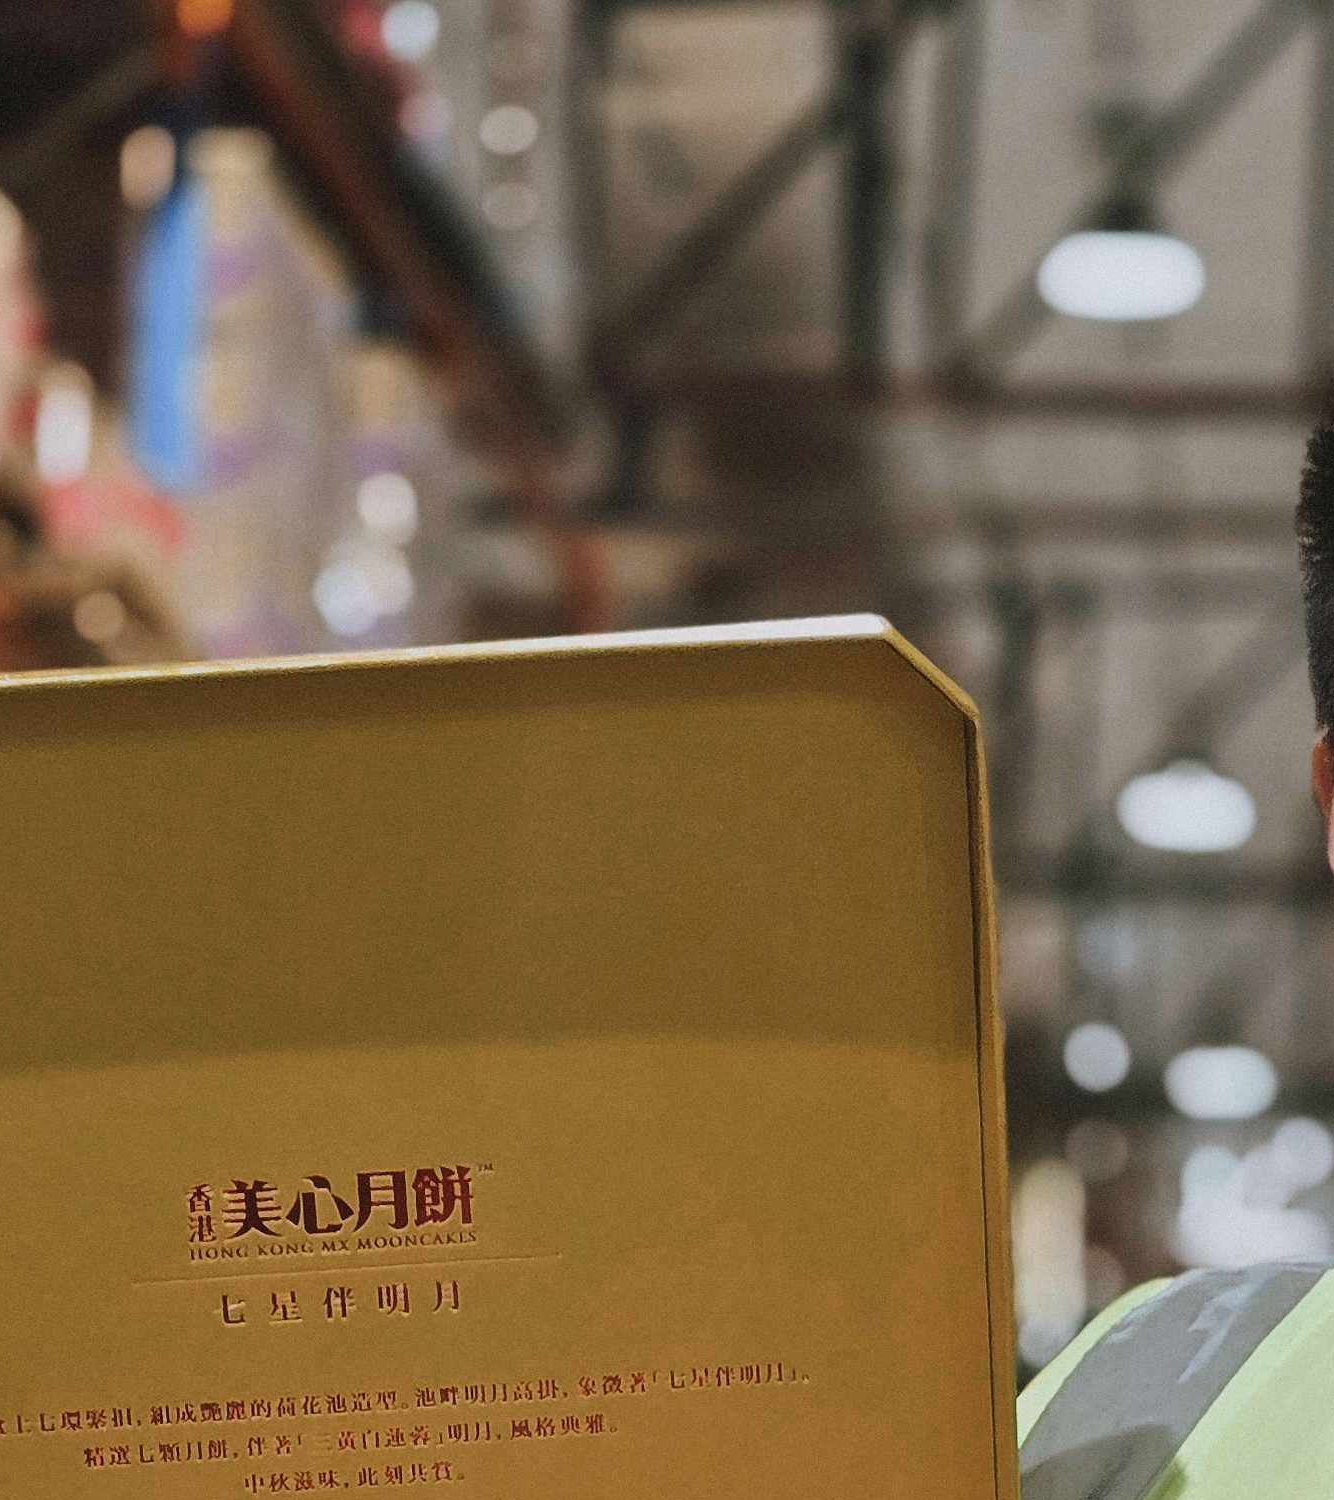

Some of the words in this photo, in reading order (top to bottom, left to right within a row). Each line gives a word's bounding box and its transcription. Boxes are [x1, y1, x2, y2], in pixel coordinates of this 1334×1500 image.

[221, 1164, 476, 1240] 美心月餅
[188, 1245, 250, 1263] HONG
[257, 1240, 314, 1257] KONG
[321, 1237, 351, 1253] MX
[356, 1229, 478, 1251] MOONCAKES
[216, 1280, 462, 1326] 七星伴明月
